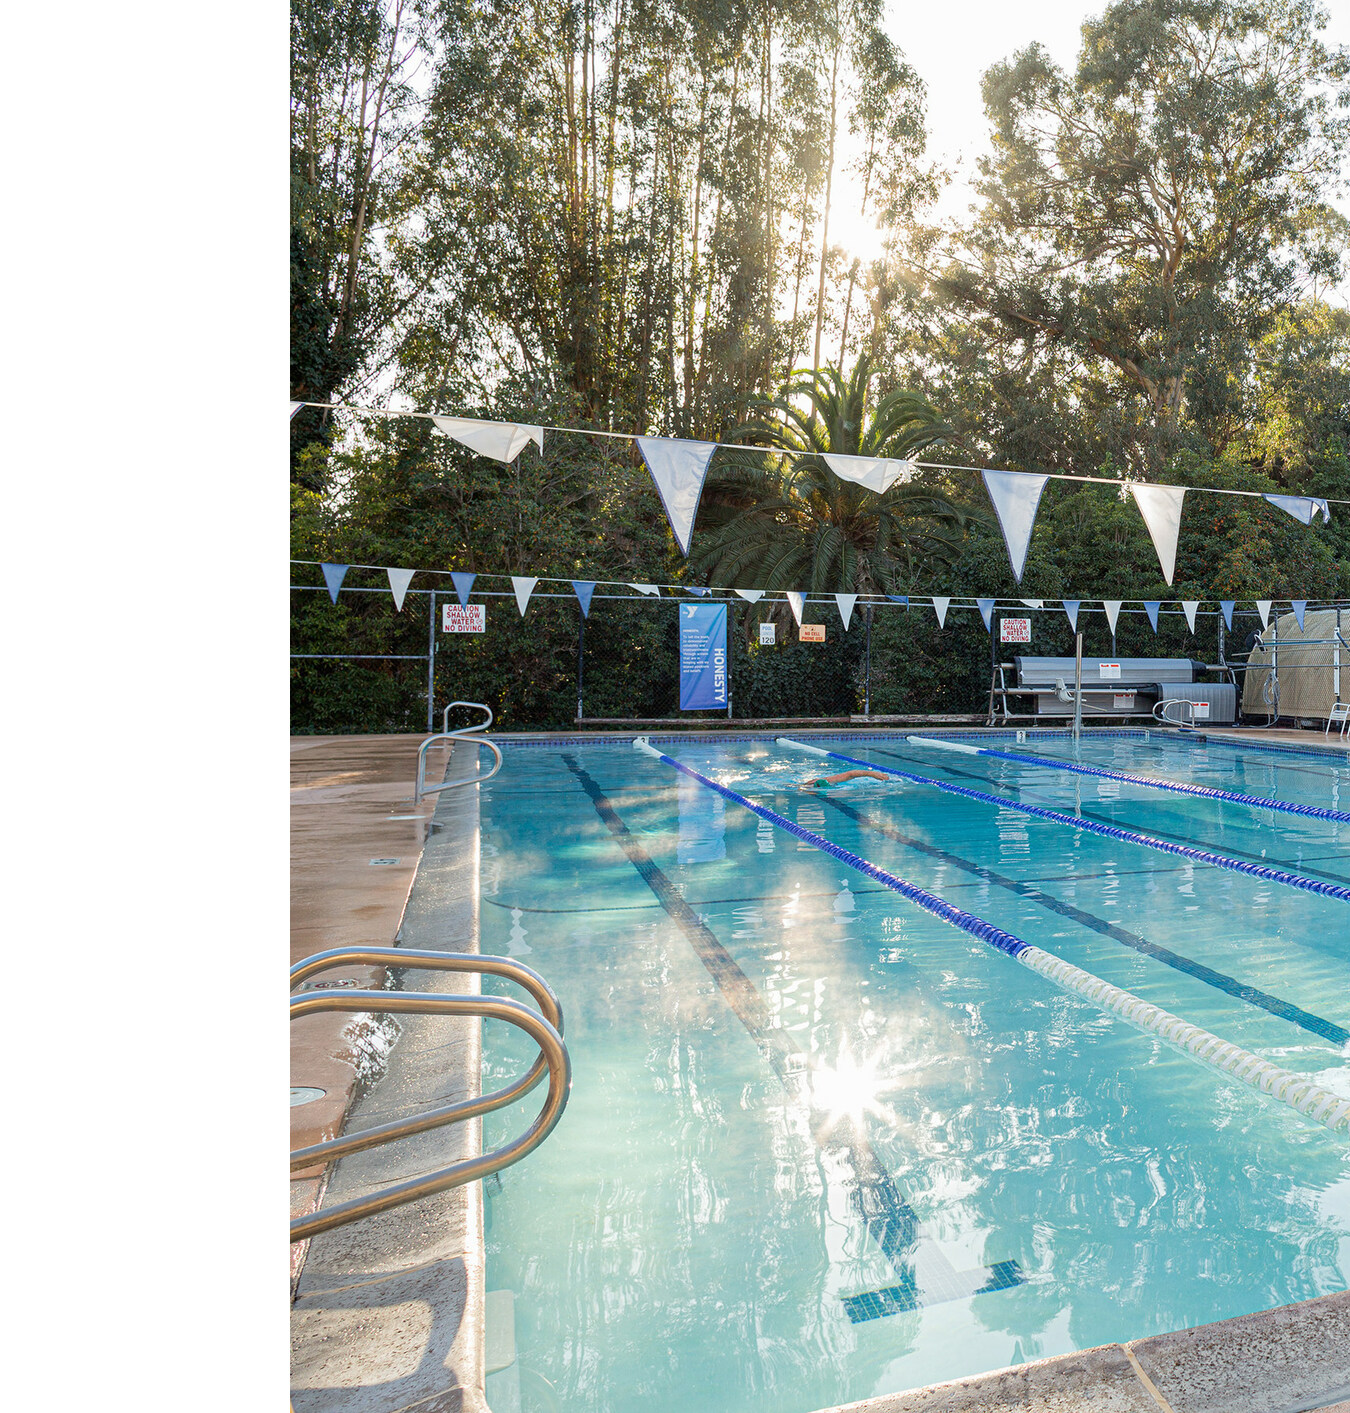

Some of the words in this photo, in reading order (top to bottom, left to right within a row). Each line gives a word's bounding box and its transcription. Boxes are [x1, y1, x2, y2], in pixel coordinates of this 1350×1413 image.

[448, 604, 480, 612] CAUION
[446, 611, 481, 619] SHALLOW
[714, 648, 726, 703] HONESTY
